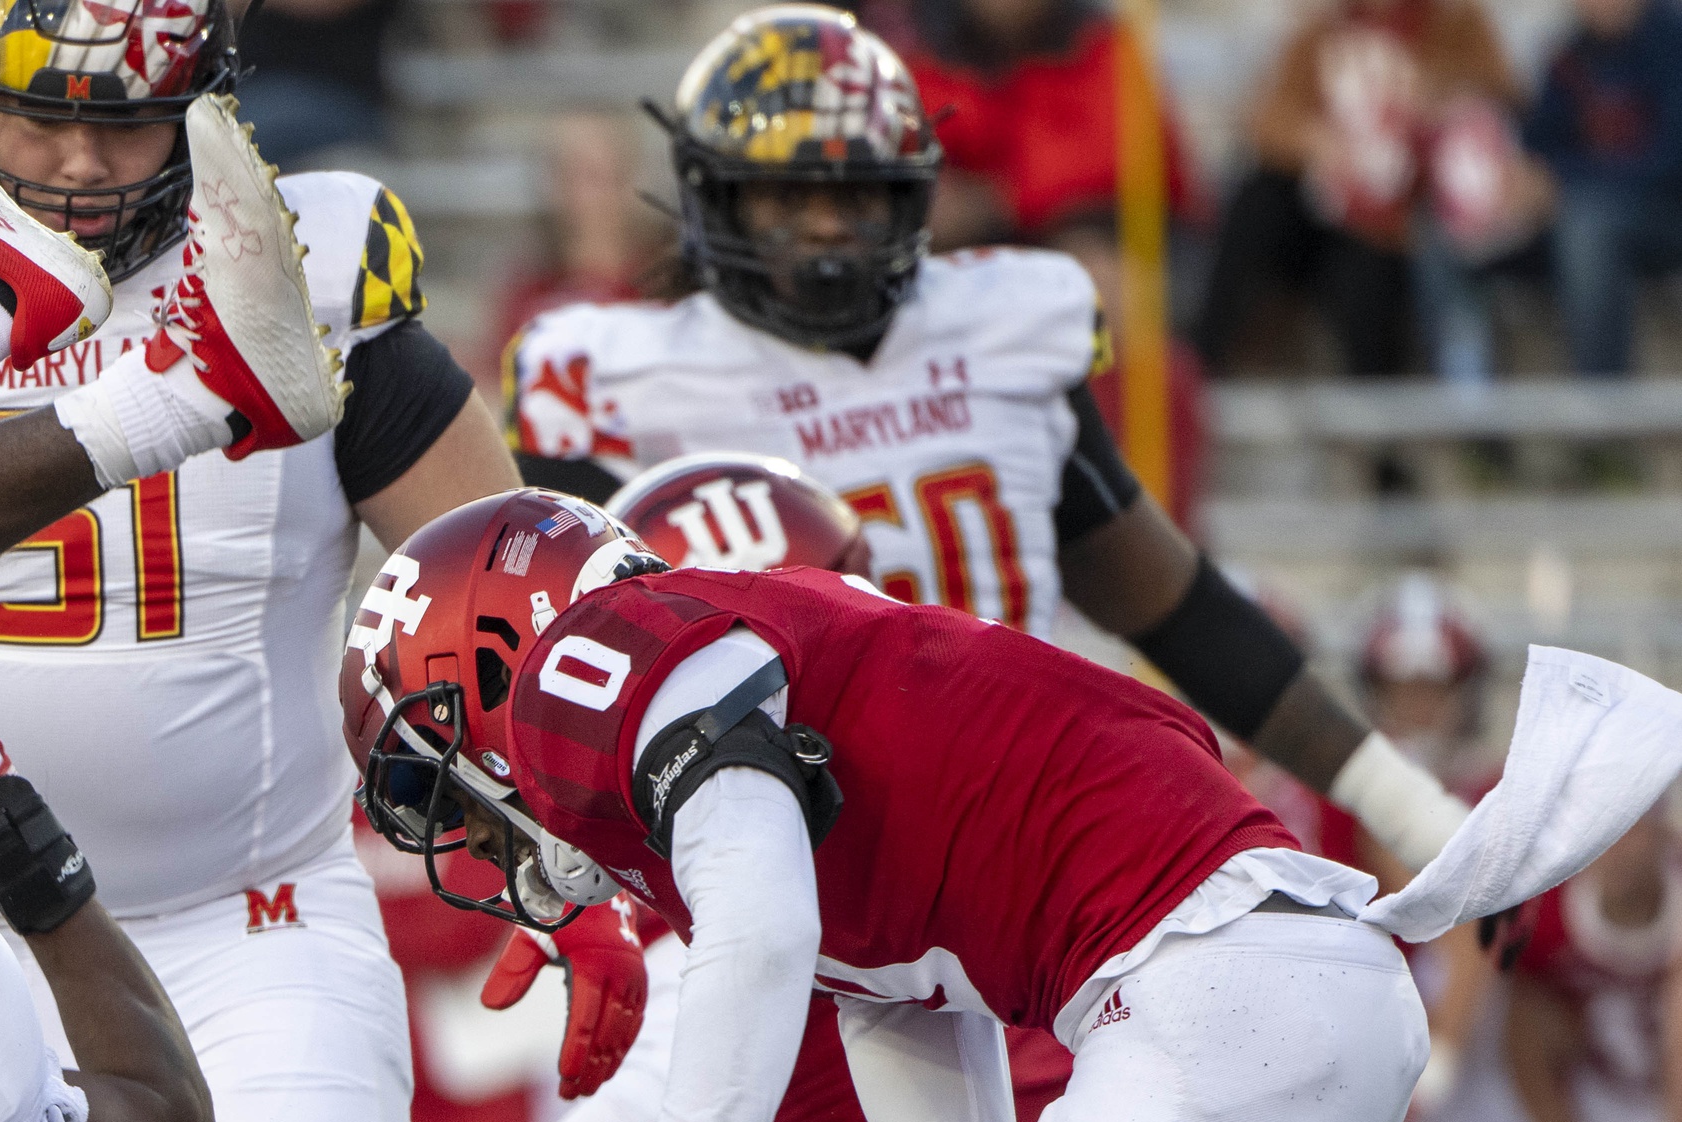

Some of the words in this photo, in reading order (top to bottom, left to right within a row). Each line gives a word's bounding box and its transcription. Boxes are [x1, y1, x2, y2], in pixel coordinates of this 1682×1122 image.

[65, 74, 93, 100] M
[797, 391, 972, 462] MARYLAND
[539, 635, 630, 711] 0
[656, 742, 699, 801] Douglas
[246, 883, 300, 930] M
